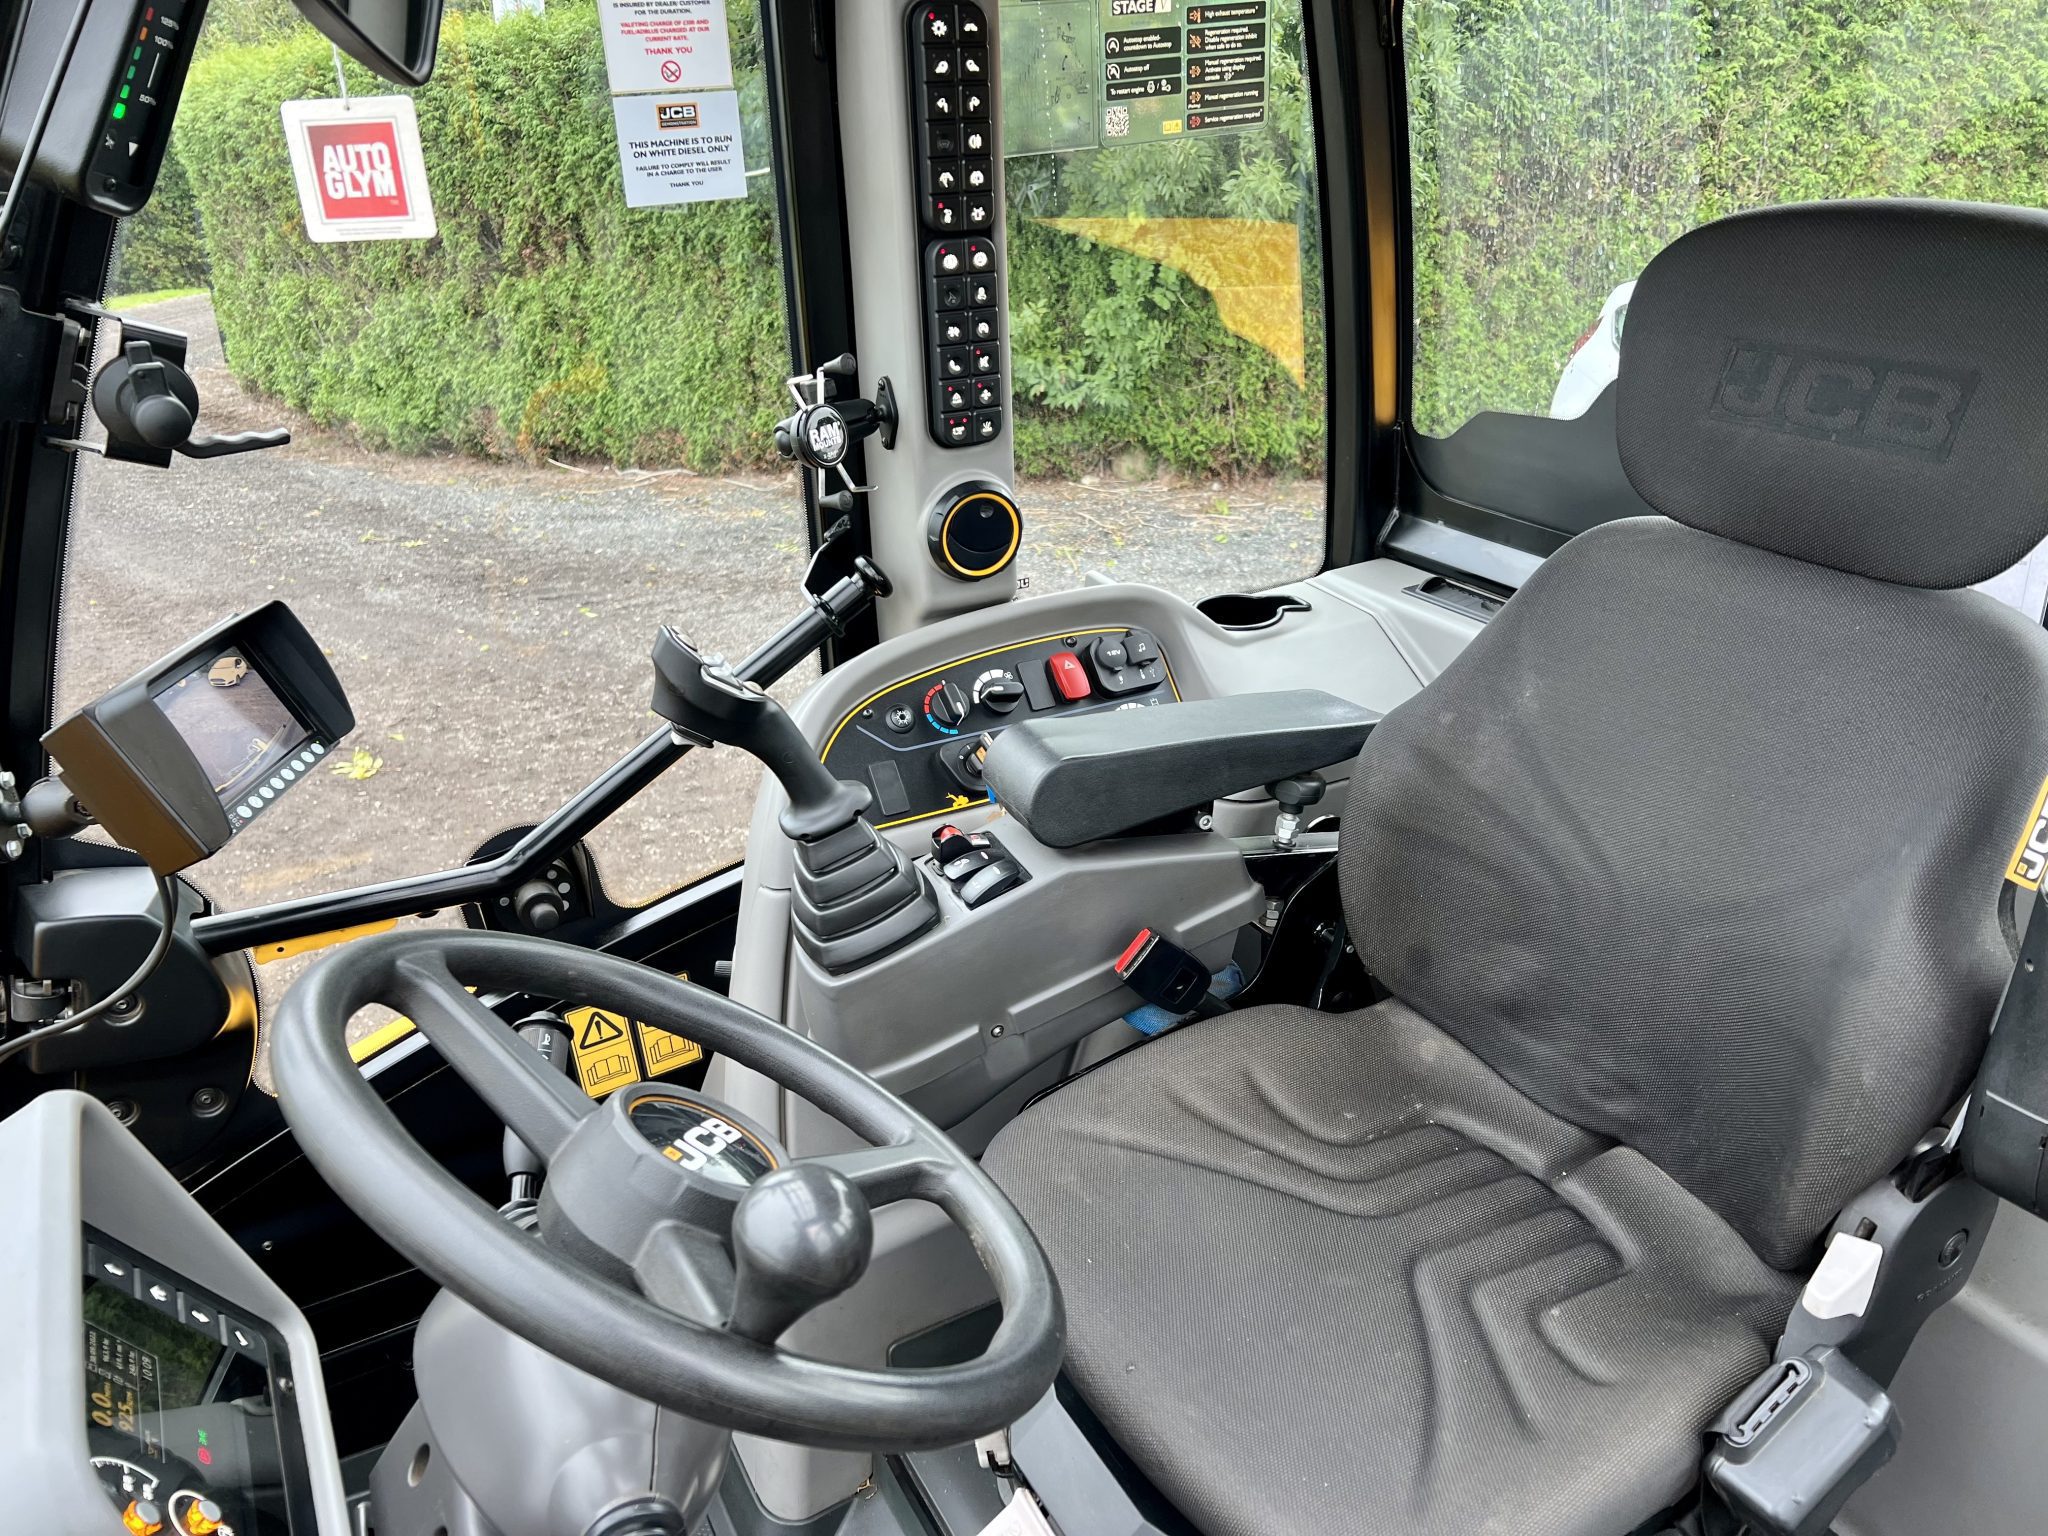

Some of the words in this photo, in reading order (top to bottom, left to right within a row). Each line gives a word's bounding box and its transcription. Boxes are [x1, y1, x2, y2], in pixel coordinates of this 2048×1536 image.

[1112, 0, 1154, 15] STAGE
[154, 36, 174, 50] 100%
[675, 46, 693, 54] YOU
[1124, 44, 1148, 52] countdown
[1131, 86, 1144, 94] engine
[139, 94, 157, 106] 50%
[660, 106, 696, 119] JCB
[650, 138, 690, 148] MACHINE
[714, 135, 732, 143] RUN
[323, 142, 392, 173] AUTO
[633, 150, 647, 158] ON
[648, 149, 676, 157] WHITE
[678, 147, 706, 156] DIESEL
[708, 145, 730, 153] ONLY
[324, 170, 397, 200] GLYM
[1720, 348, 1965, 455] JCB
[809, 421, 840, 444] RAM
[2022, 794, 2048, 880] JC
[673, 1117, 743, 1172] JCB
[92, 1392, 112, 1426] 0.0
[118, 1402, 134, 1432] 925
